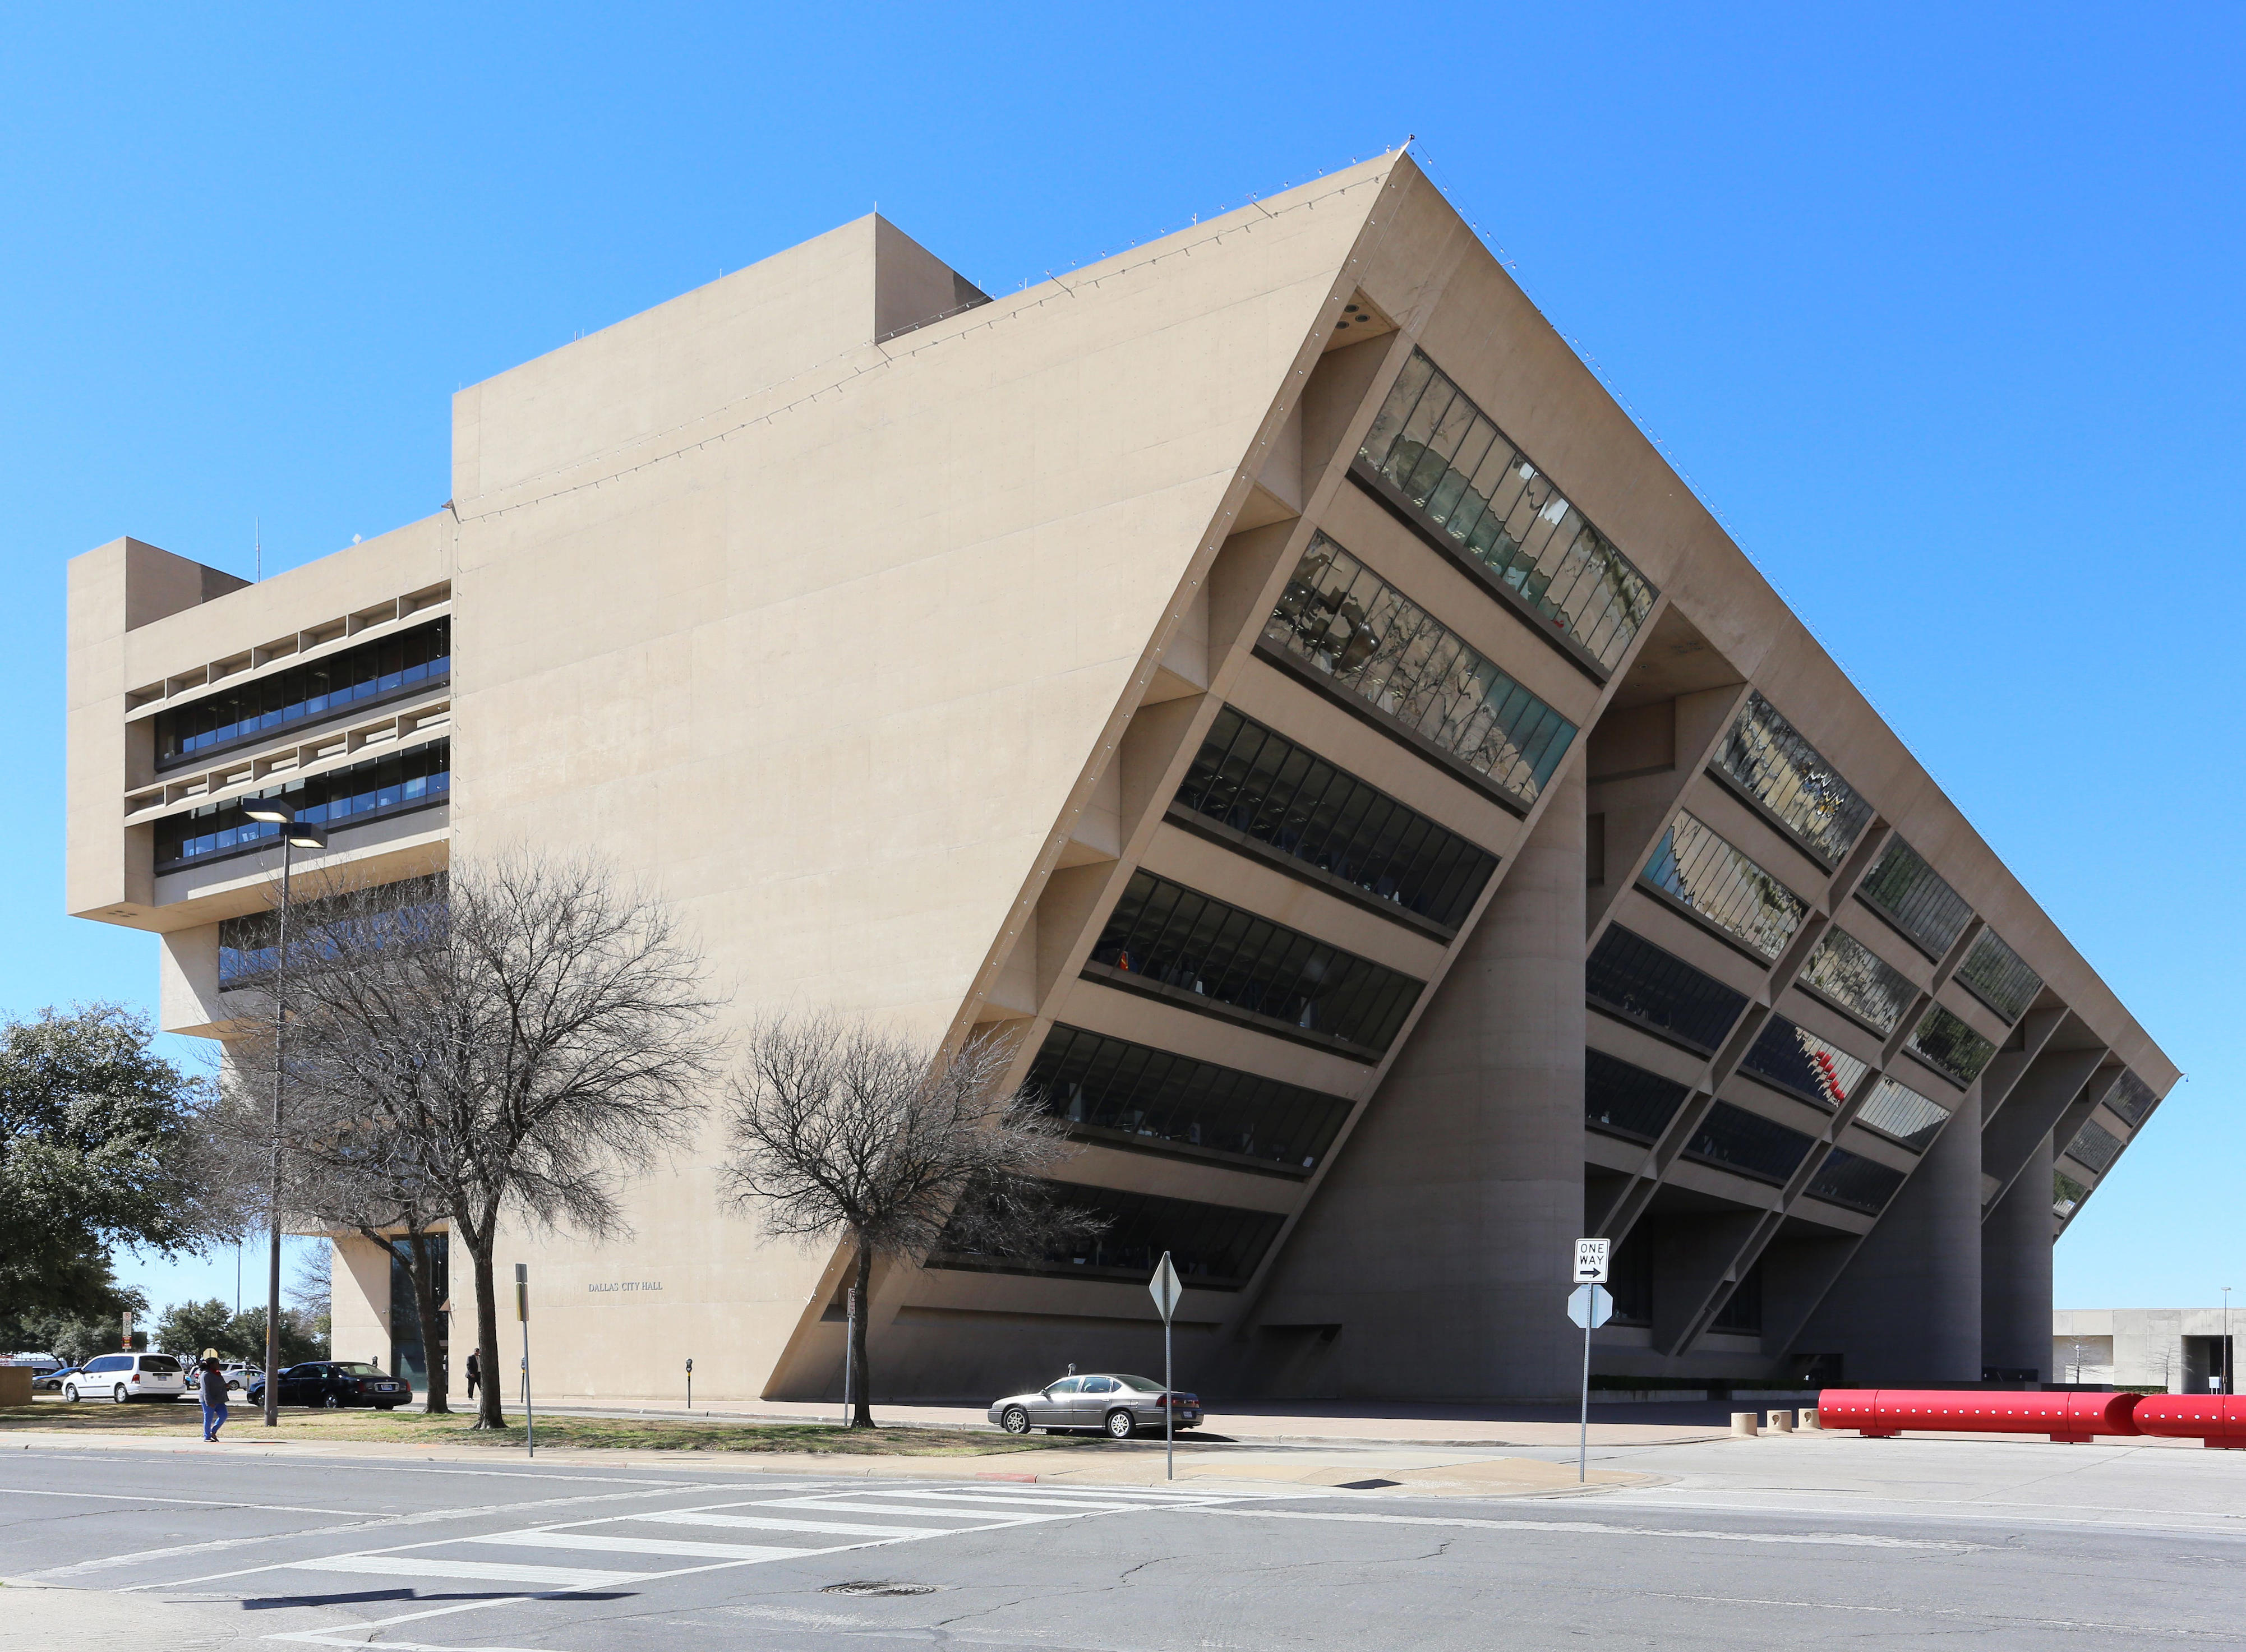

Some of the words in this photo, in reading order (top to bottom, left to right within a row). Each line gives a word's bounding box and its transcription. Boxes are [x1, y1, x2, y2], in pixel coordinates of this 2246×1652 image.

[1581, 1243, 1604, 1253] ONE
[1580, 1256, 1604, 1265] WAY
[589, 1284, 619, 1292] DALLAS
[621, 1282, 640, 1291] CITY
[642, 1282, 663, 1290] HALL
